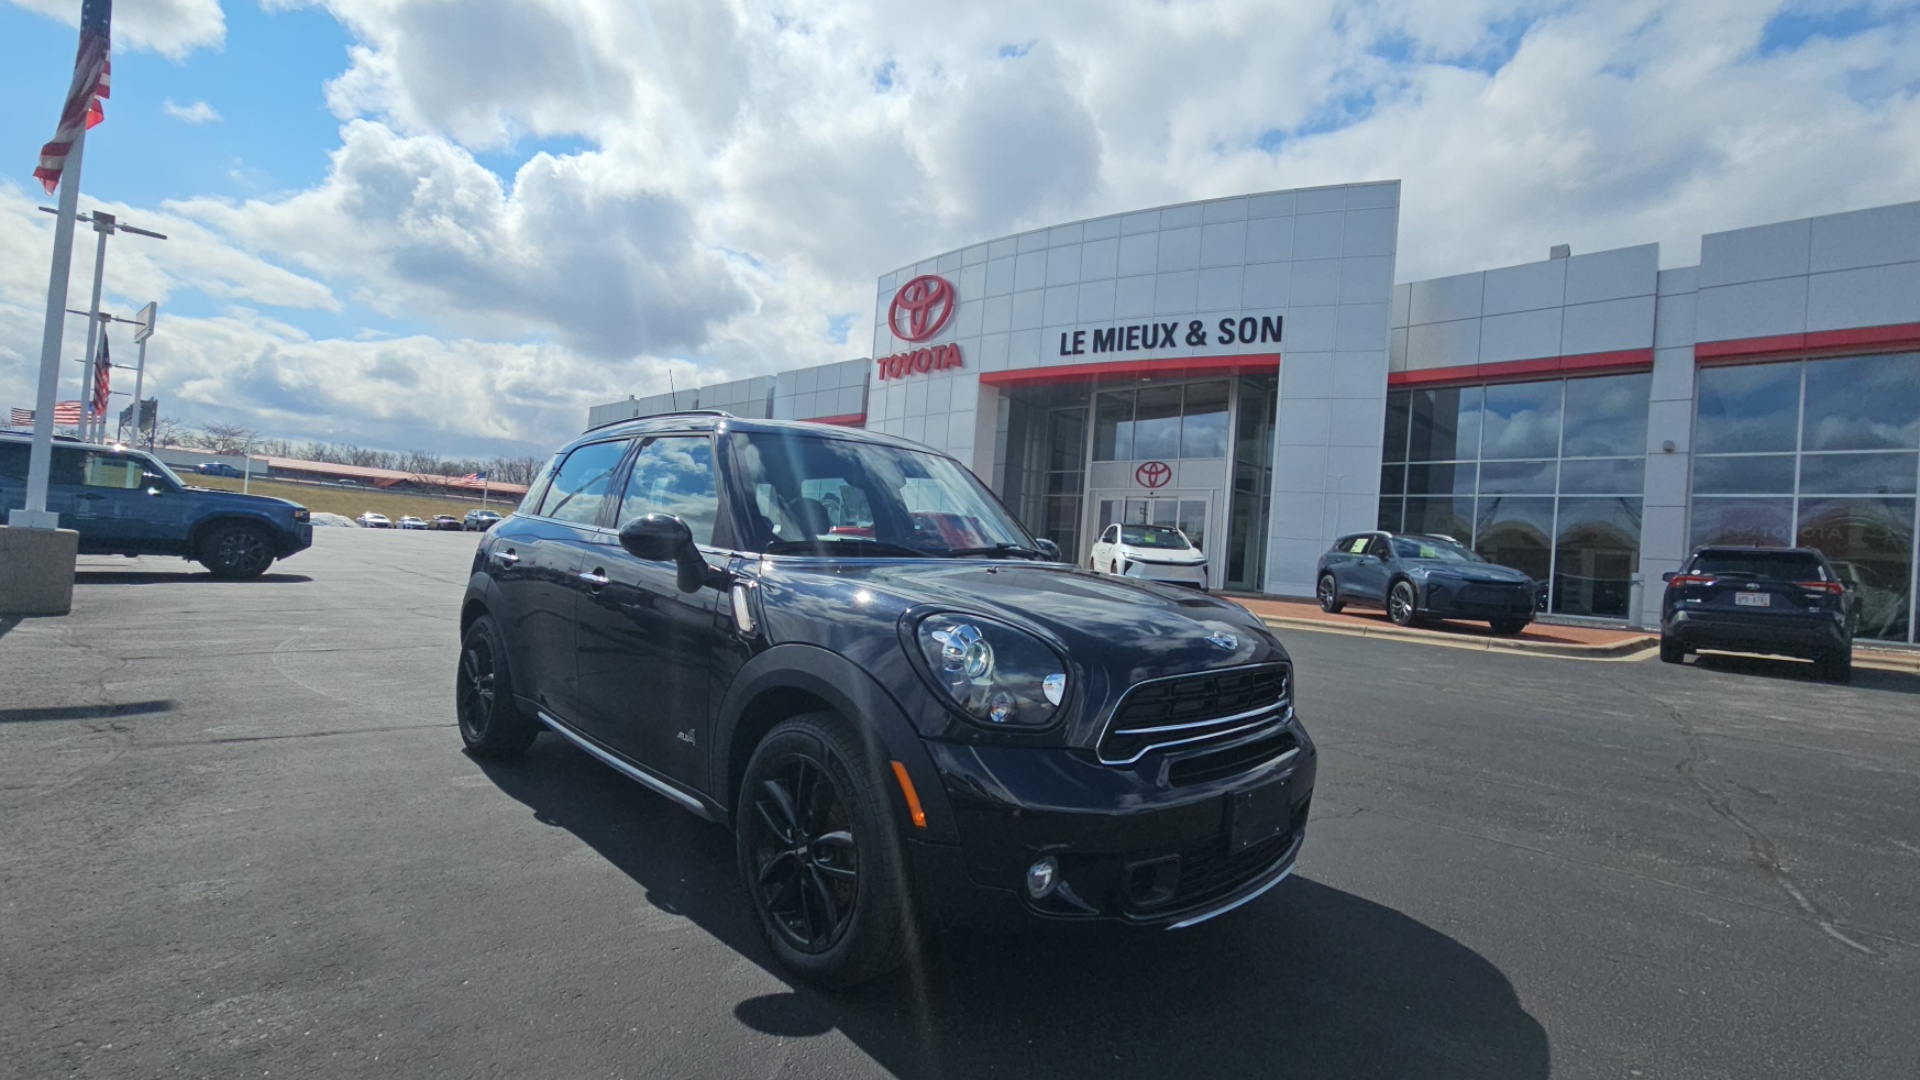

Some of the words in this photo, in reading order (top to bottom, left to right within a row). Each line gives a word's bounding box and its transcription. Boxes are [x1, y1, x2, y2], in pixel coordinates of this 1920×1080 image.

[1060, 330, 1086, 356] LE
[1092, 322, 1179, 353] MIEUX
[1185, 320, 1208, 346] &
[1218, 315, 1283, 345] SON
[877, 342, 964, 380] TOYOTA
